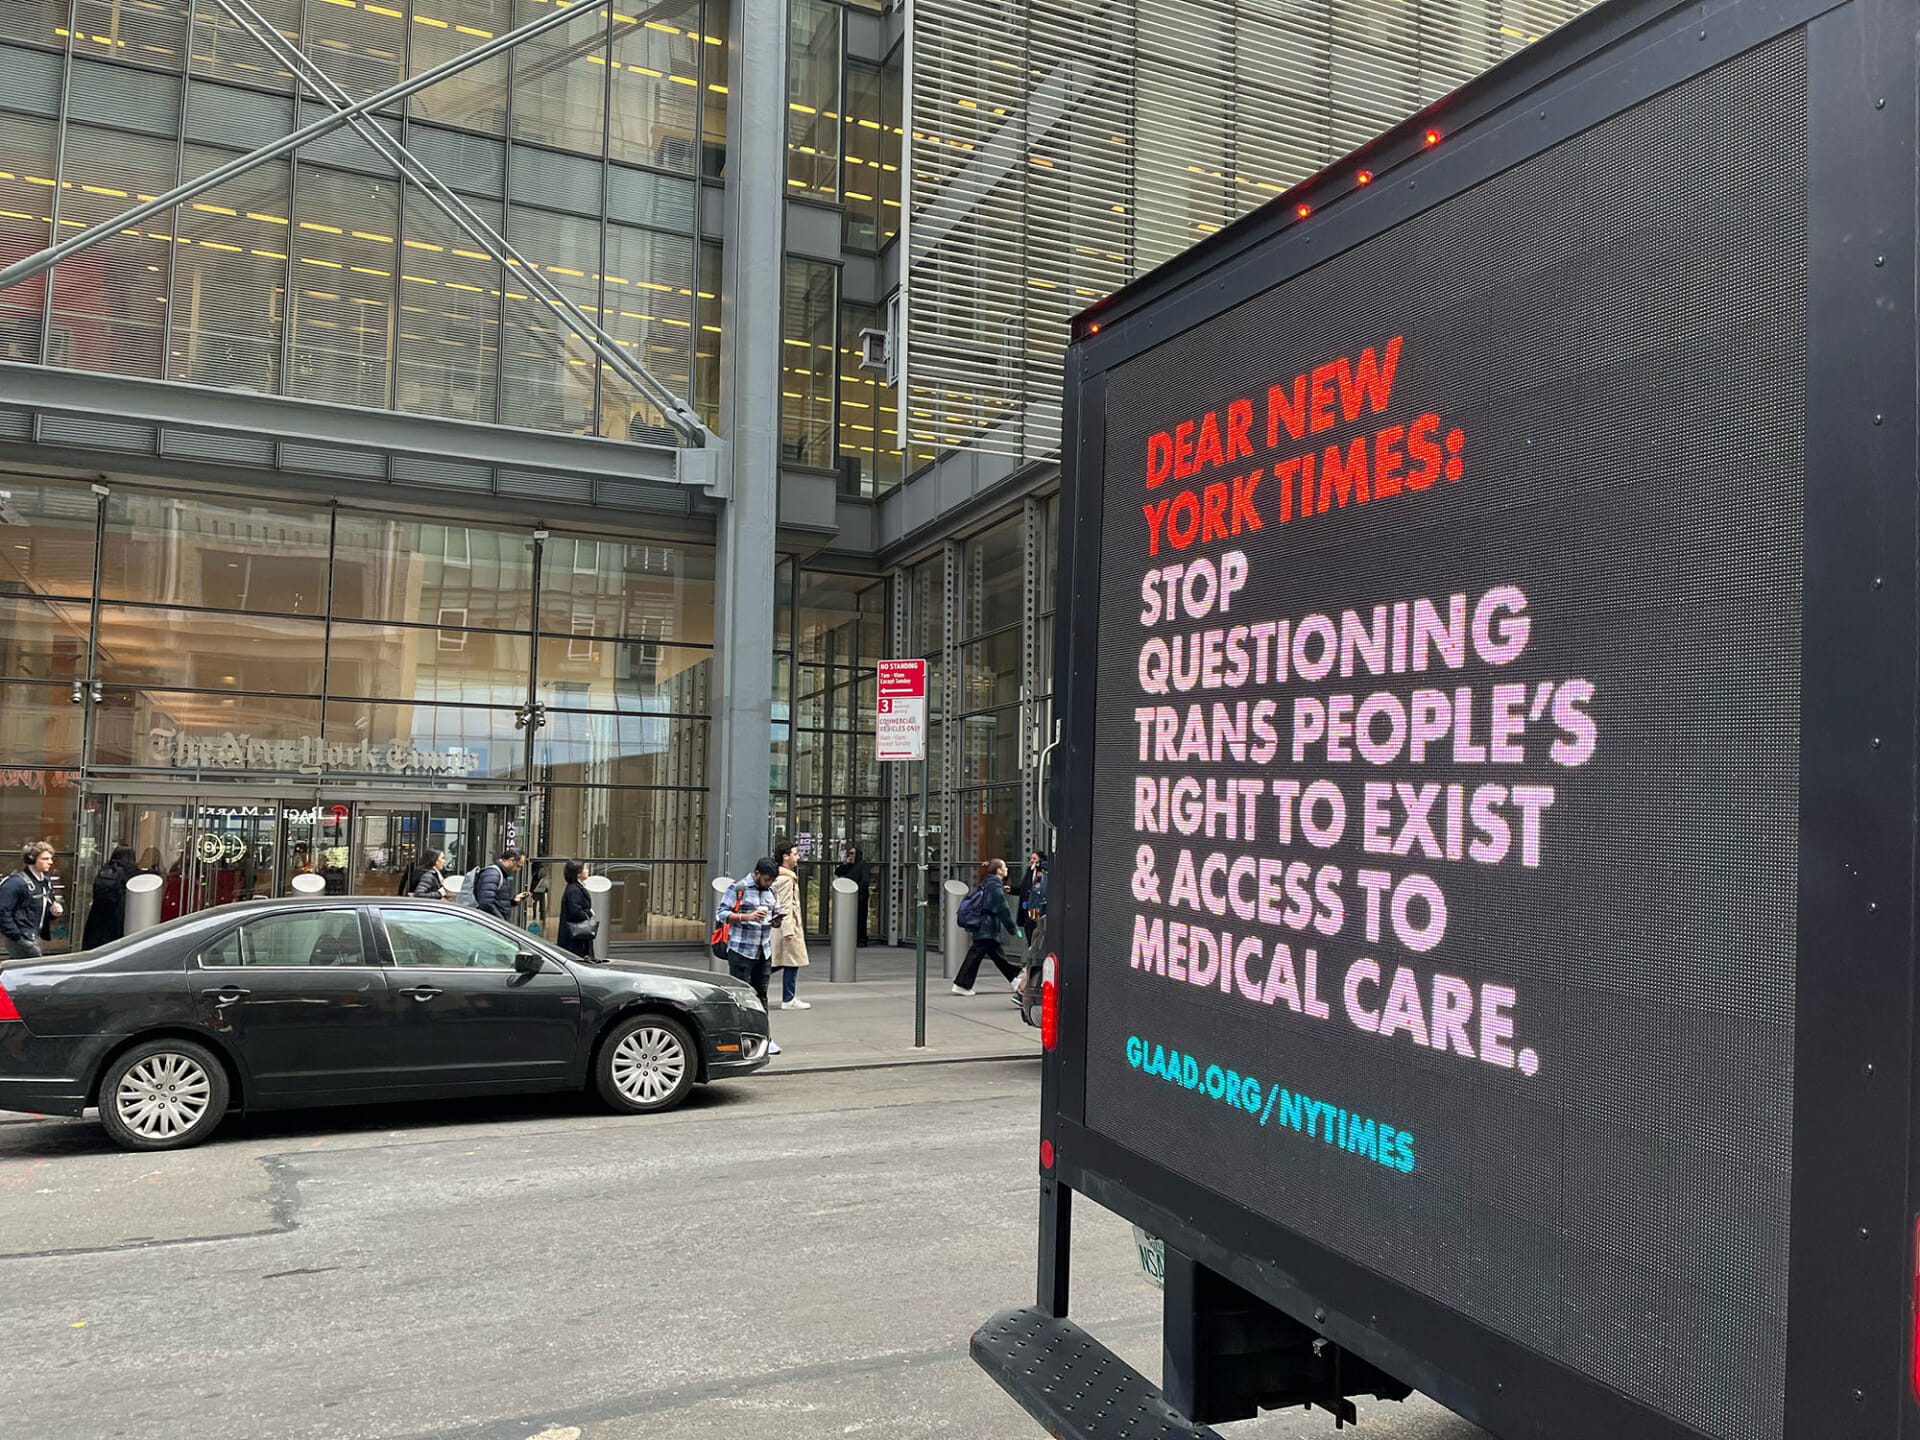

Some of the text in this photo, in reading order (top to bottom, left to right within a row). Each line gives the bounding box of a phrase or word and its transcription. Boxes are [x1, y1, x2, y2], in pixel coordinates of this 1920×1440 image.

[1146, 336, 1403, 489] DEAR NEW
[1143, 412, 1464, 556] YORK TIMES:
[1140, 551, 1248, 626] STOP
[890, 662, 918, 670] STANDING
[1138, 585, 1532, 695] QUESTIONING
[150, 727, 479, 775] The New York Times
[881, 699, 889, 712] 3
[1134, 678, 1600, 768] TRANS PEOPLE'S
[1134, 776, 1556, 868] RIGHT TO EXIST
[1131, 845, 1448, 952] & ACCESS TO
[1130, 914, 1540, 1077] MEDICAL CARE.
[1126, 1036, 1415, 1173] GLAAD.ORG/NYTIMES
